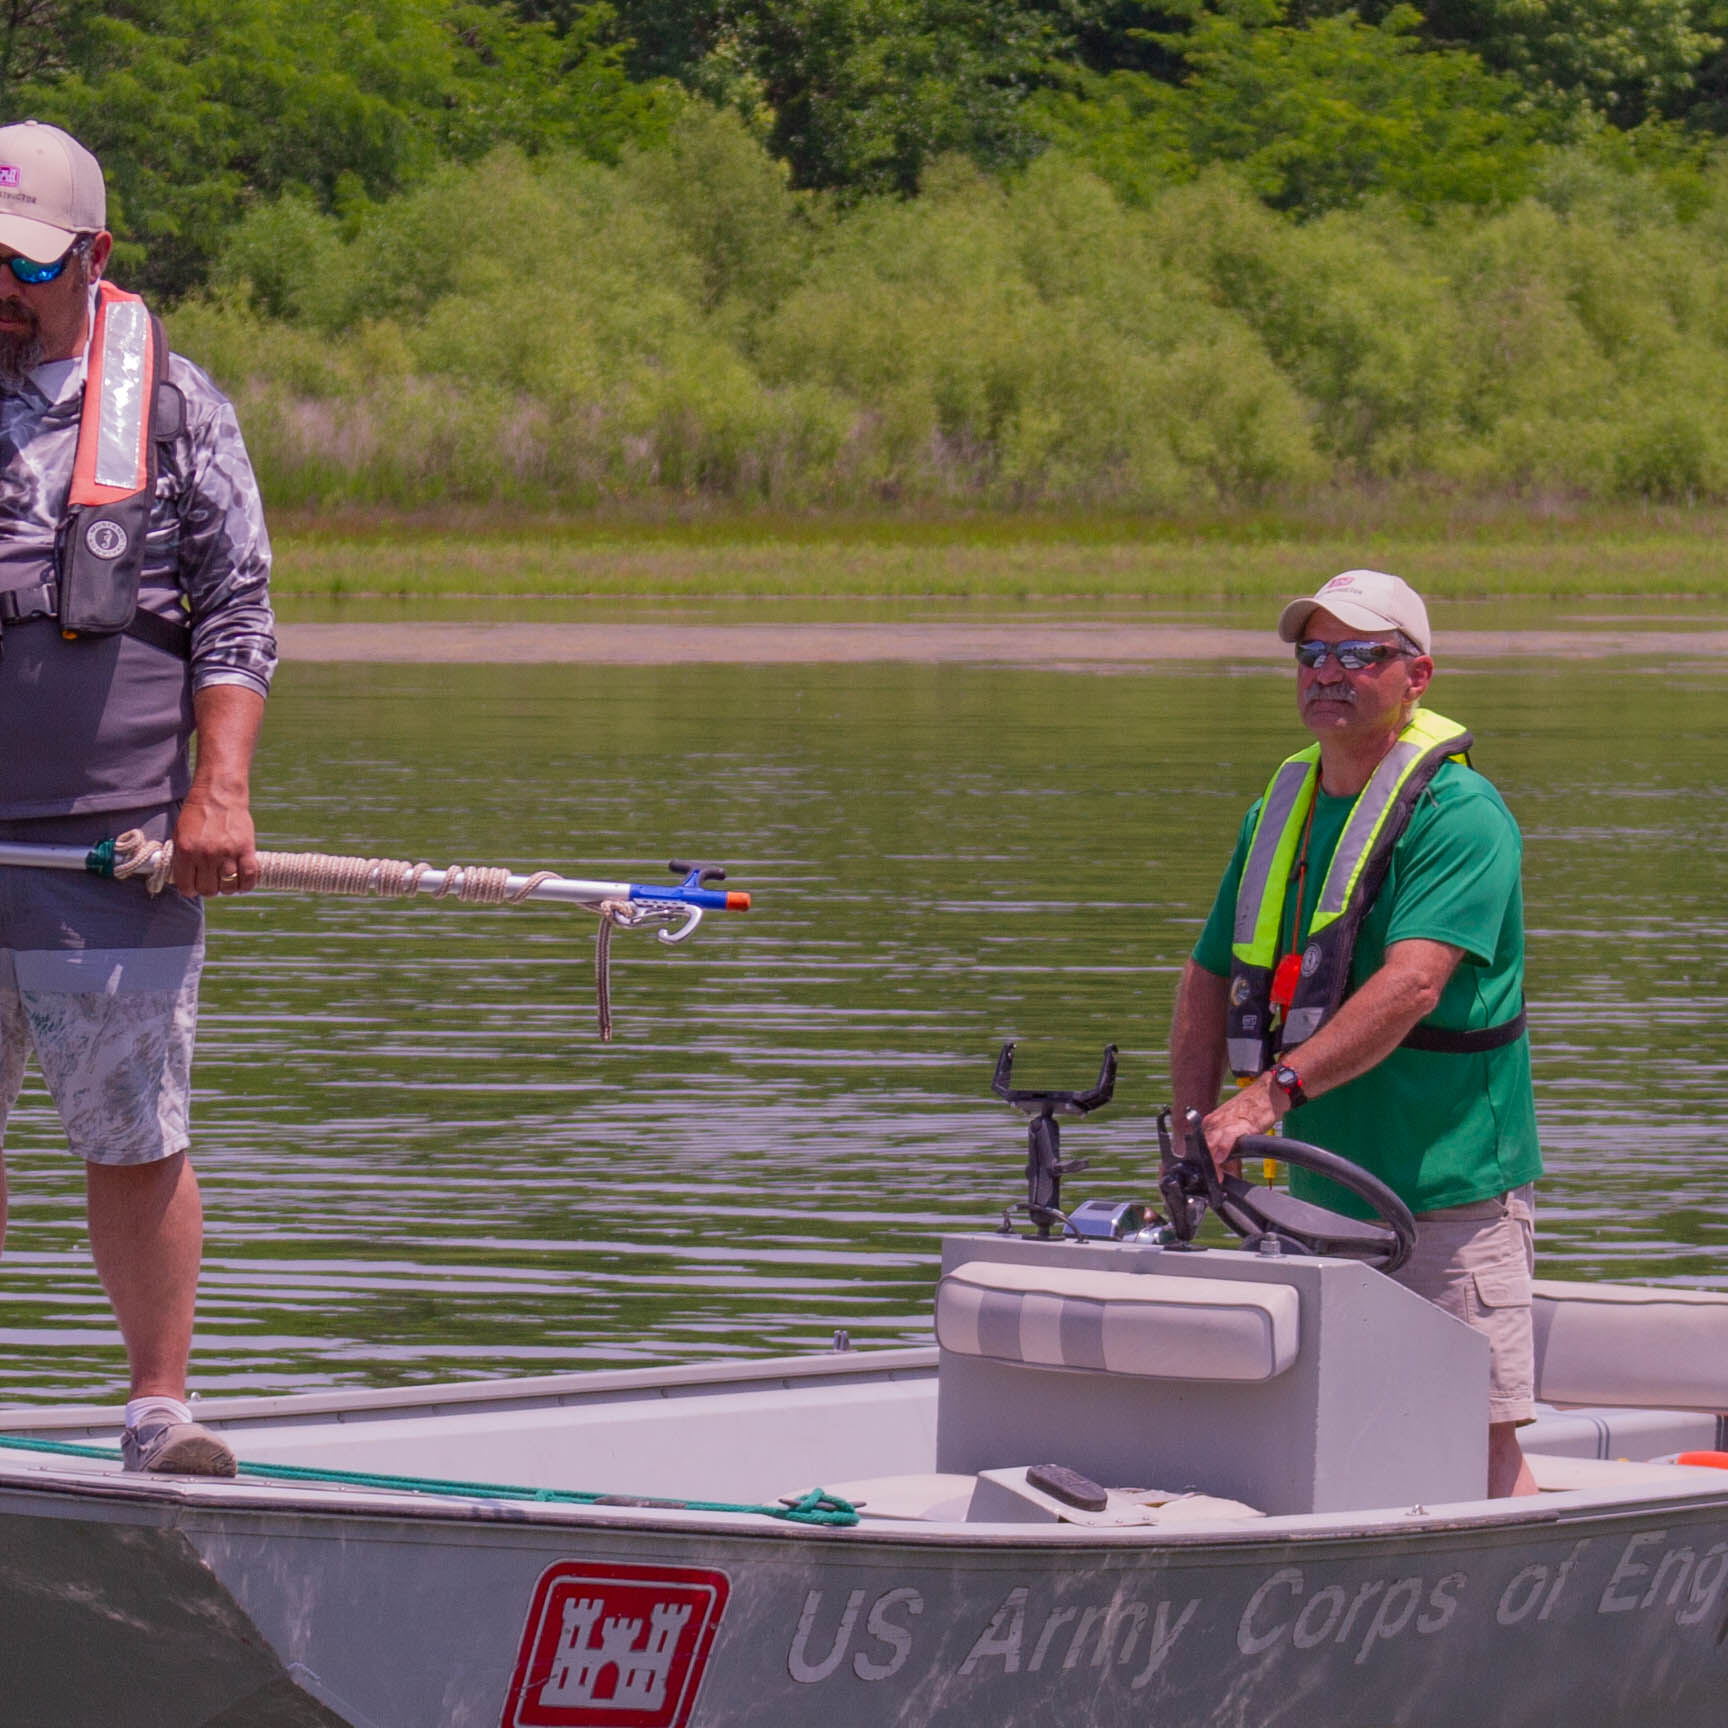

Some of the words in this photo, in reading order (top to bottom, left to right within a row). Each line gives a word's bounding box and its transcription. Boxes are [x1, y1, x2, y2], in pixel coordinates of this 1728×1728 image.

[787, 1587, 924, 1683] US
[957, 1587, 1203, 1690] Army
[1237, 1567, 1467, 1664] Corps
